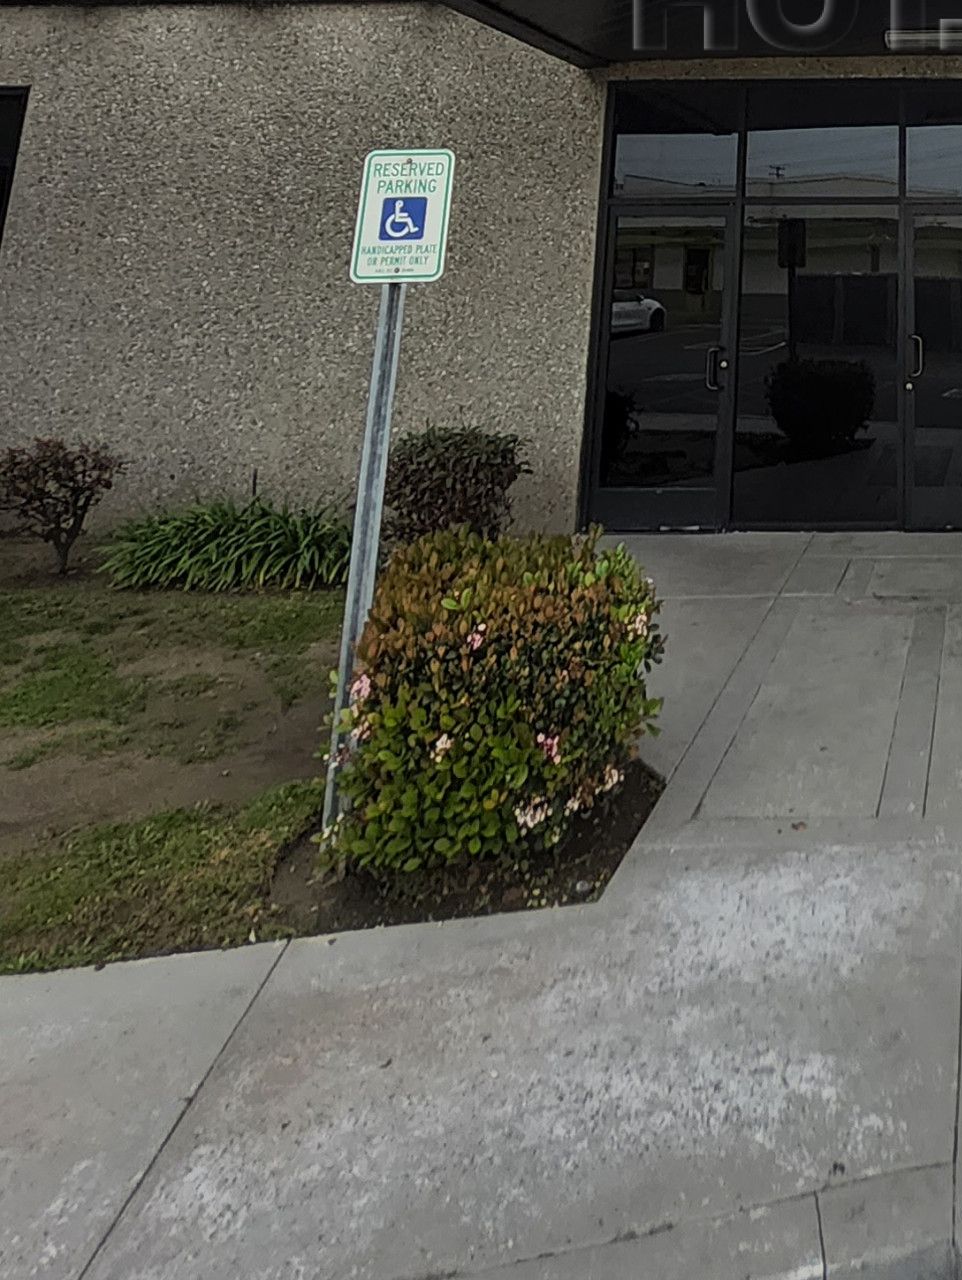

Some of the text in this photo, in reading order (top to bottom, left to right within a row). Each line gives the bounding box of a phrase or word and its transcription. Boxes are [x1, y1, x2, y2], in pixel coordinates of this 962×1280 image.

[373, 162, 445, 177] RESERVED
[377, 179, 437, 193] PARKING
[361, 244, 438, 254] HANDICAPPED PLATE
[380, 256, 406, 265] PERMIT
[409, 255, 429, 265] ONLY
